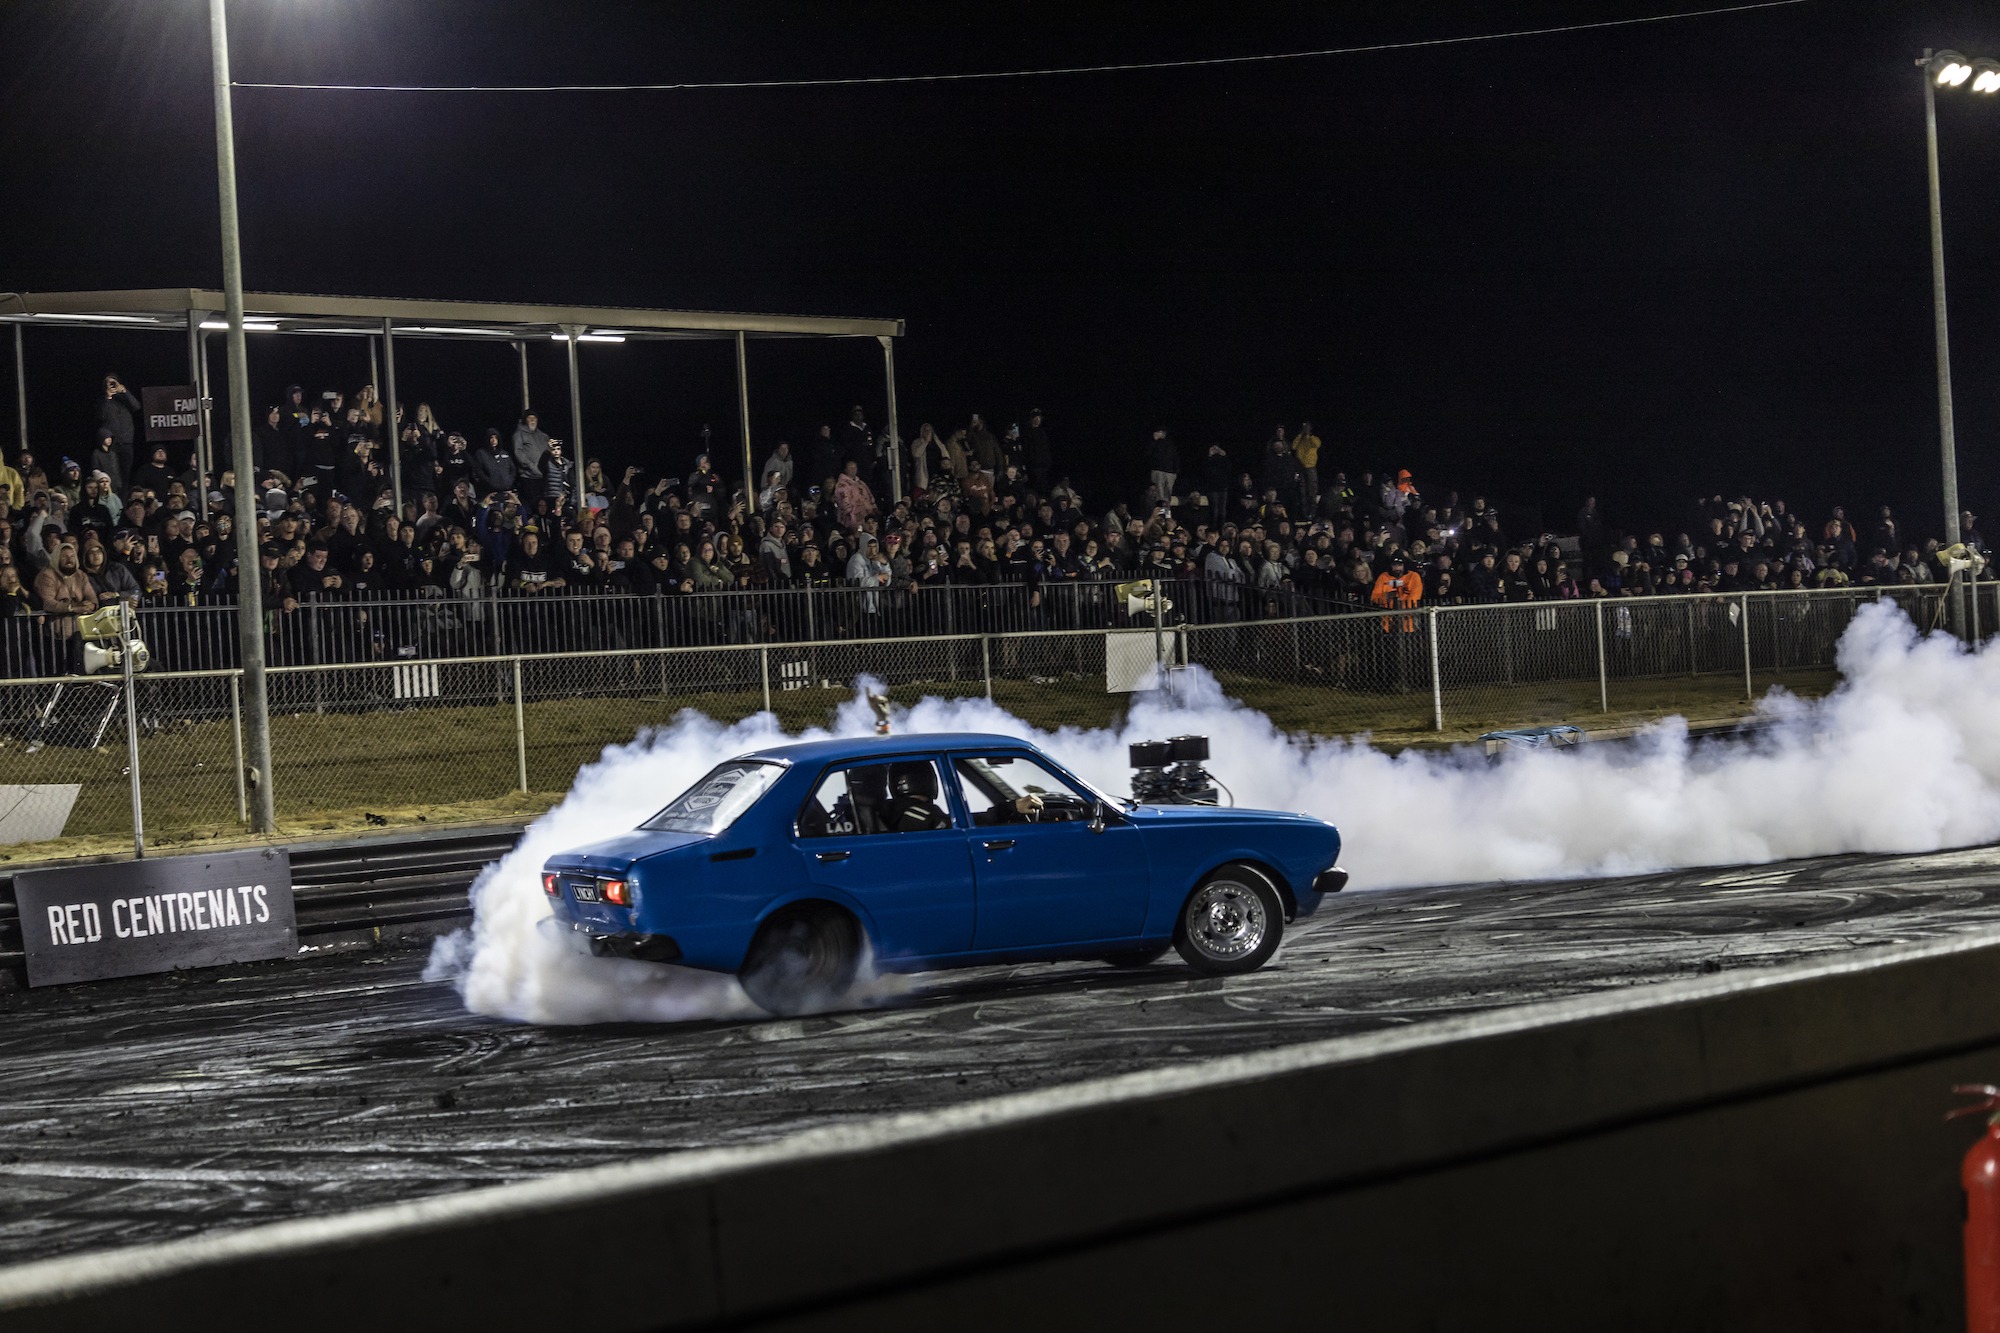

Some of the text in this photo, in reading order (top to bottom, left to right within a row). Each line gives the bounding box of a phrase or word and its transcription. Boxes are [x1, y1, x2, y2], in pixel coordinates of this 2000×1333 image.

[150, 413, 198, 428] FRIENDL
[826, 821, 854, 833] LAD
[47, 885, 270, 946] RED CENTRENATS
